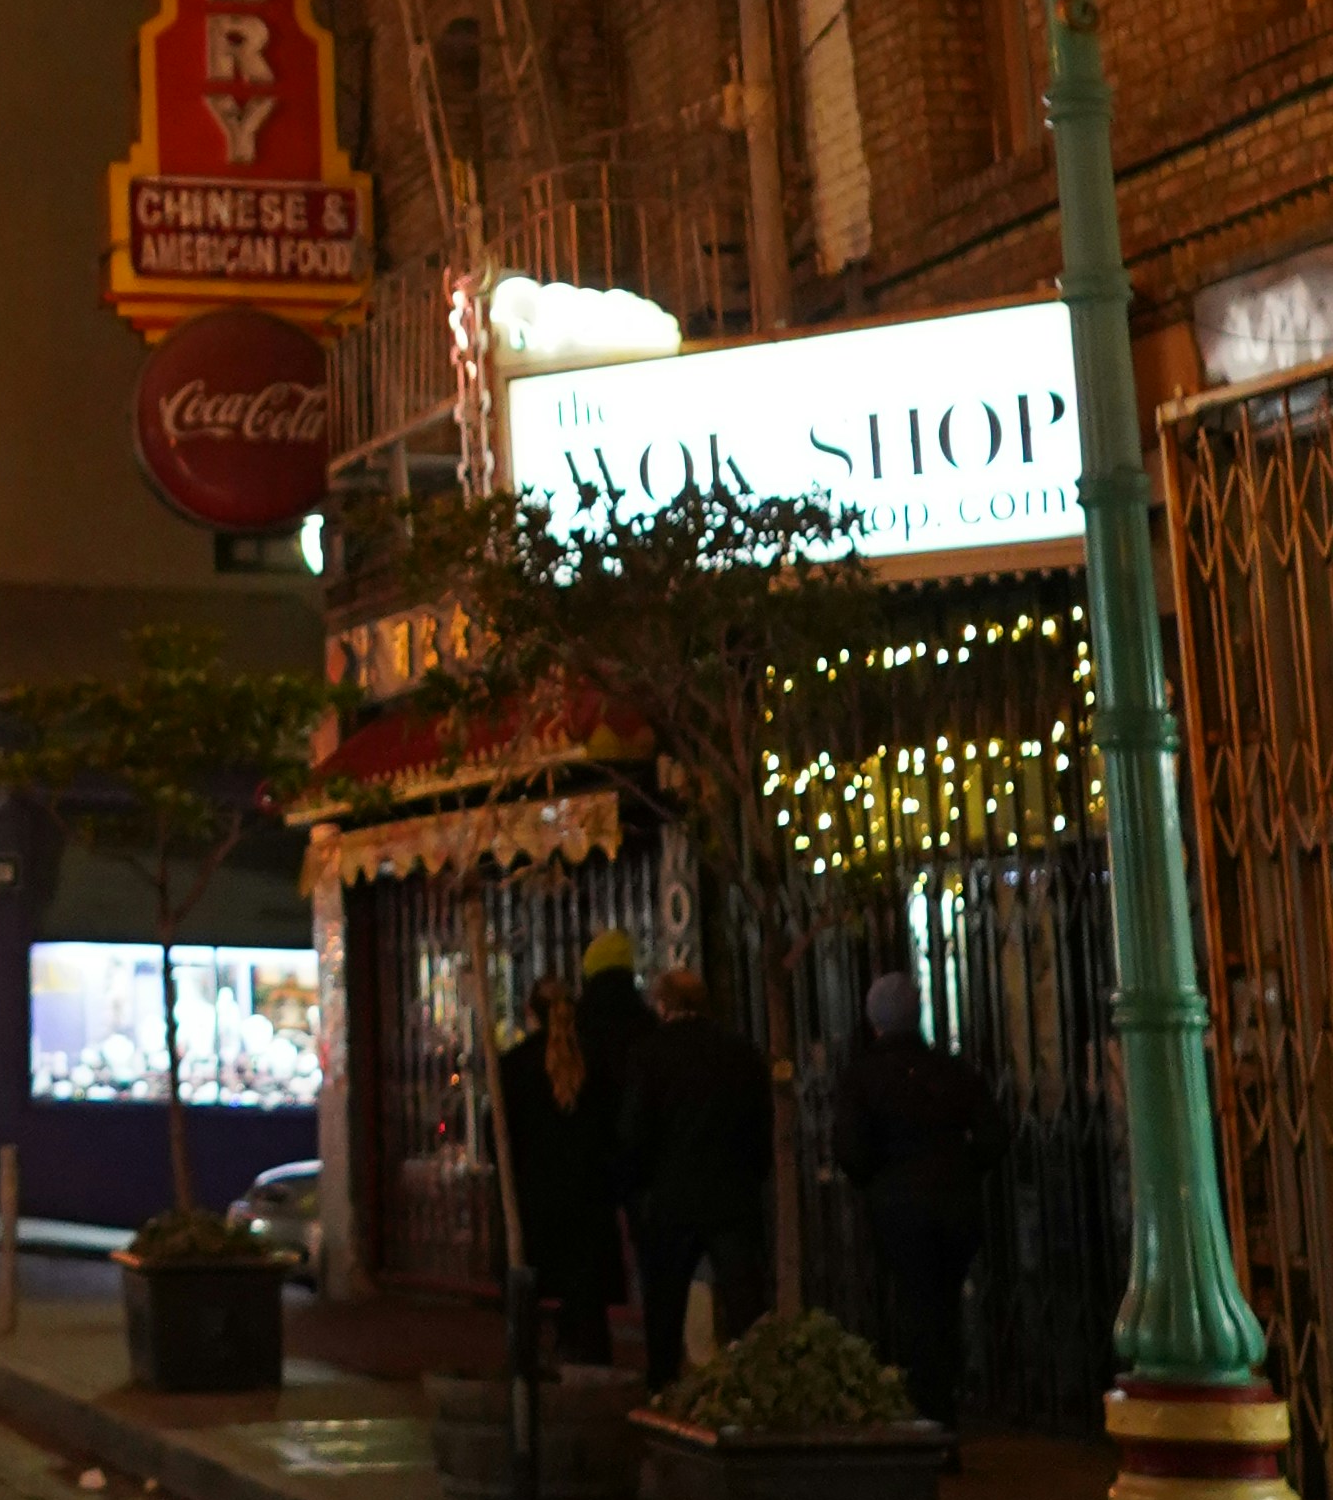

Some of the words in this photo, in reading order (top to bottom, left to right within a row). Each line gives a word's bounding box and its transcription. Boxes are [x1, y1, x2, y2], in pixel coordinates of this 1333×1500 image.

[136, 187, 309, 230] CHINESE
[321, 192, 349, 232] &
[140, 233, 276, 274] AMERICAN
[280, 238, 353, 277] FOOD
[809, 390, 1066, 479] SHOP
